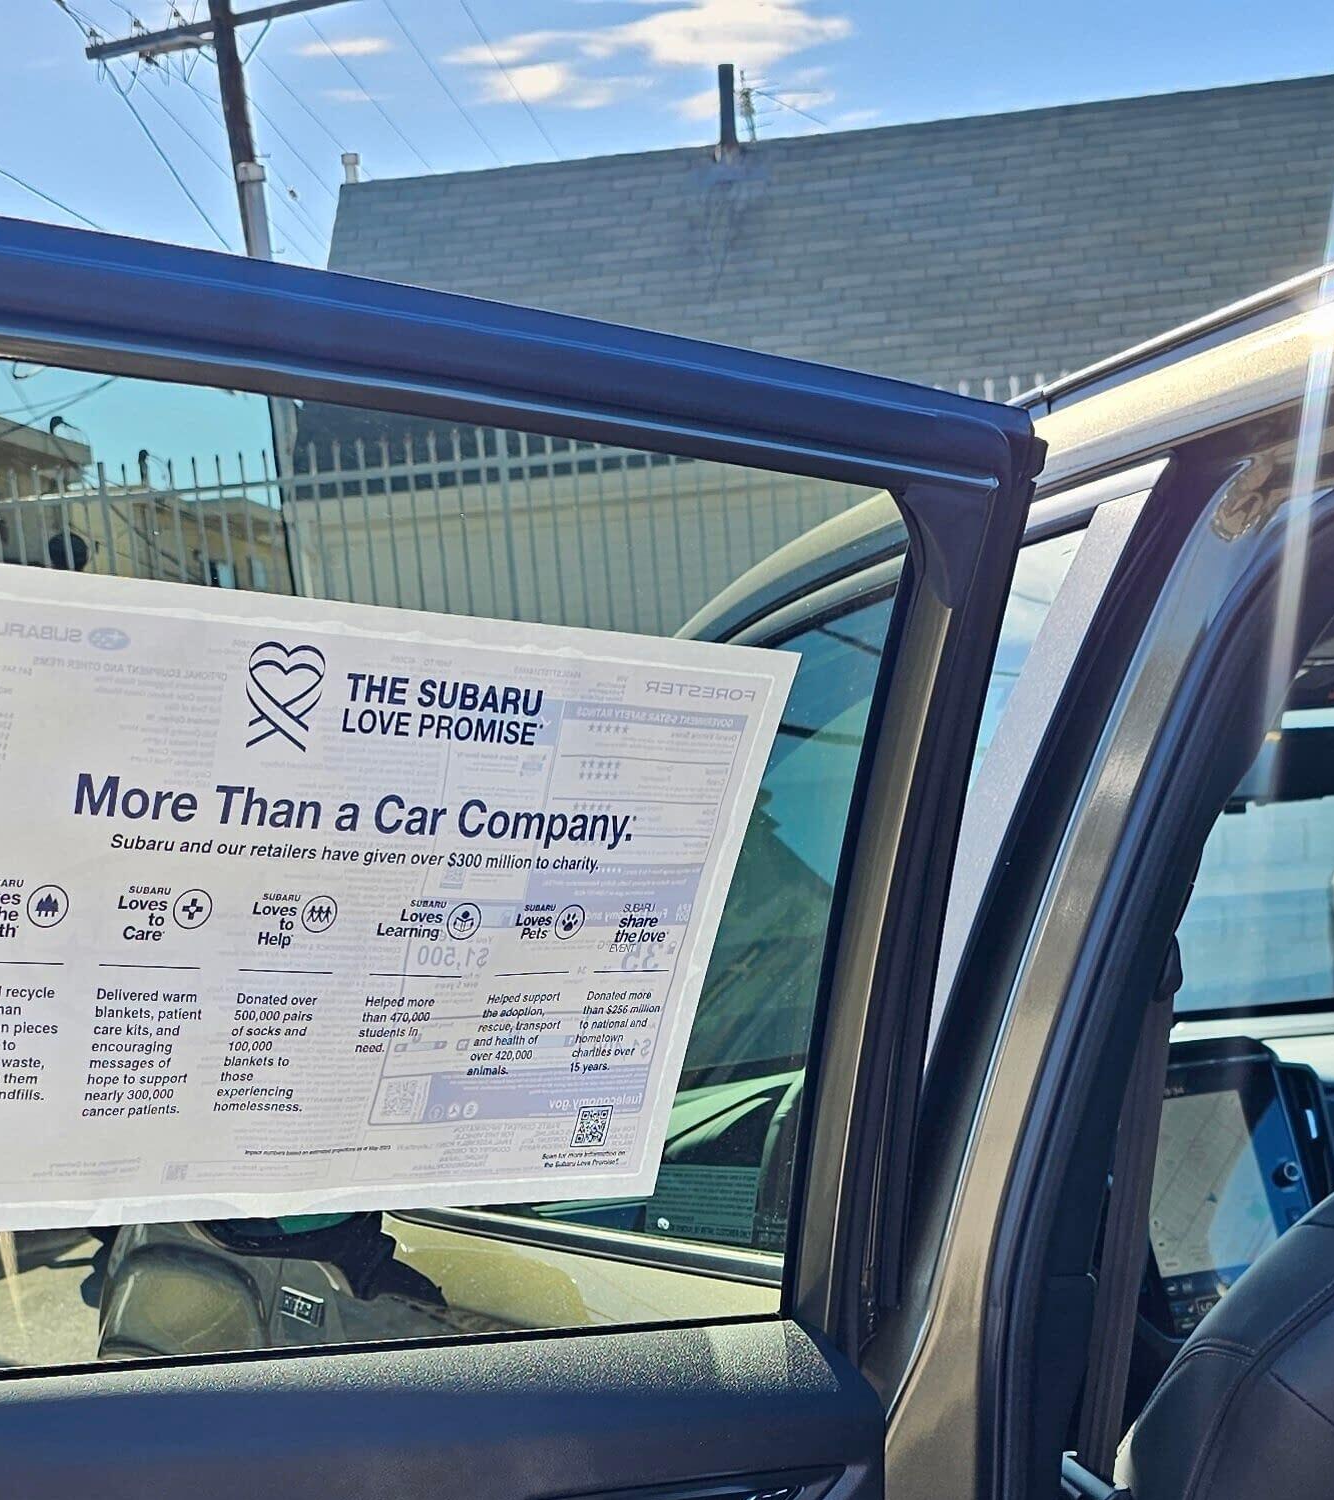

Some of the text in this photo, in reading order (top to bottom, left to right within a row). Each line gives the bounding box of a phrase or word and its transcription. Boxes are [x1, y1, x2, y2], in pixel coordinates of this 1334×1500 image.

[346, 672, 409, 708] THE
[417, 679, 543, 717] SUBARU
[343, 708, 409, 738] LOVE
[72, 773, 199, 824] More
[214, 786, 320, 832] Than
[334, 802, 360, 833] a
[374, 794, 447, 837] Car
[110, 833, 599, 874] Subaru and our retailers have given over $300 million to charity.
[128, 885, 171, 896] SUBARU
[117, 896, 167, 911] Loves
[262, 893, 301, 902] SUBARU
[252, 902, 297, 917] Loves
[410, 900, 447, 909] SUBARU
[524, 903, 556, 911] SUBARU
[623, 903, 655, 912] SUBARU
[148, 912, 165, 927] to
[400, 909, 443, 924] Loves
[516, 913, 552, 927] Loves
[618, 914, 658, 929] share
[279, 918, 294, 931] to
[123, 926, 162, 941] Care
[376, 923, 440, 941] Learning
[614, 930, 665, 943] the love
[608, 943, 636, 953] EVENT
[5, 987, 55, 1000] recycle
[96, 988, 198, 1003] Delivered warm
[236, 993, 317, 1005] Donated over
[486, 991, 561, 1005] Helped support
[586, 991, 652, 1001] Donated more
[365, 996, 435, 1009] Helped more
[582, 1003, 660, 1015] than $256 million
[94, 1007, 202, 1022] blankets, patient
[234, 1010, 313, 1024] 500,000 pairs
[362, 1011, 430, 1023] than 470,000
[482, 1006, 545, 1018] the adoption,
[13, 1022, 58, 1035] pieces
[93, 1024, 180, 1037] care kits, and
[477, 1020, 561, 1034] rescue, transport
[579, 1018, 648, 1030] to national and
[231, 1026, 307, 1037] of socks and
[358, 1027, 418, 1038] students in
[473, 1035, 539, 1046] and health of
[575, 1033, 624, 1044] hometown
[2, 1040, 16, 1051] to
[91, 1041, 172, 1055] encouraging
[228, 1041, 272, 1053] 100,000
[355, 1043, 385, 1054] need.
[470, 1050, 533, 1061] over 420,000
[571, 1047, 636, 1058] charities over
[1, 1058, 45, 1070] waste,
[89, 1057, 172, 1070] messages of
[223, 1056, 289, 1067] blankets to
[467, 1065, 509, 1076] animals.
[570, 1063, 610, 1074] 15 years.
[3, 1073, 38, 1085] them
[87, 1073, 187, 1086] hope to support
[220, 1071, 253, 1082] those
[84, 1088, 174, 1102] nearly 300,000
[216, 1086, 293, 1099] experiencing
[81, 1104, 180, 1118] cancer patients.
[213, 1101, 303, 1113] homelessness.
